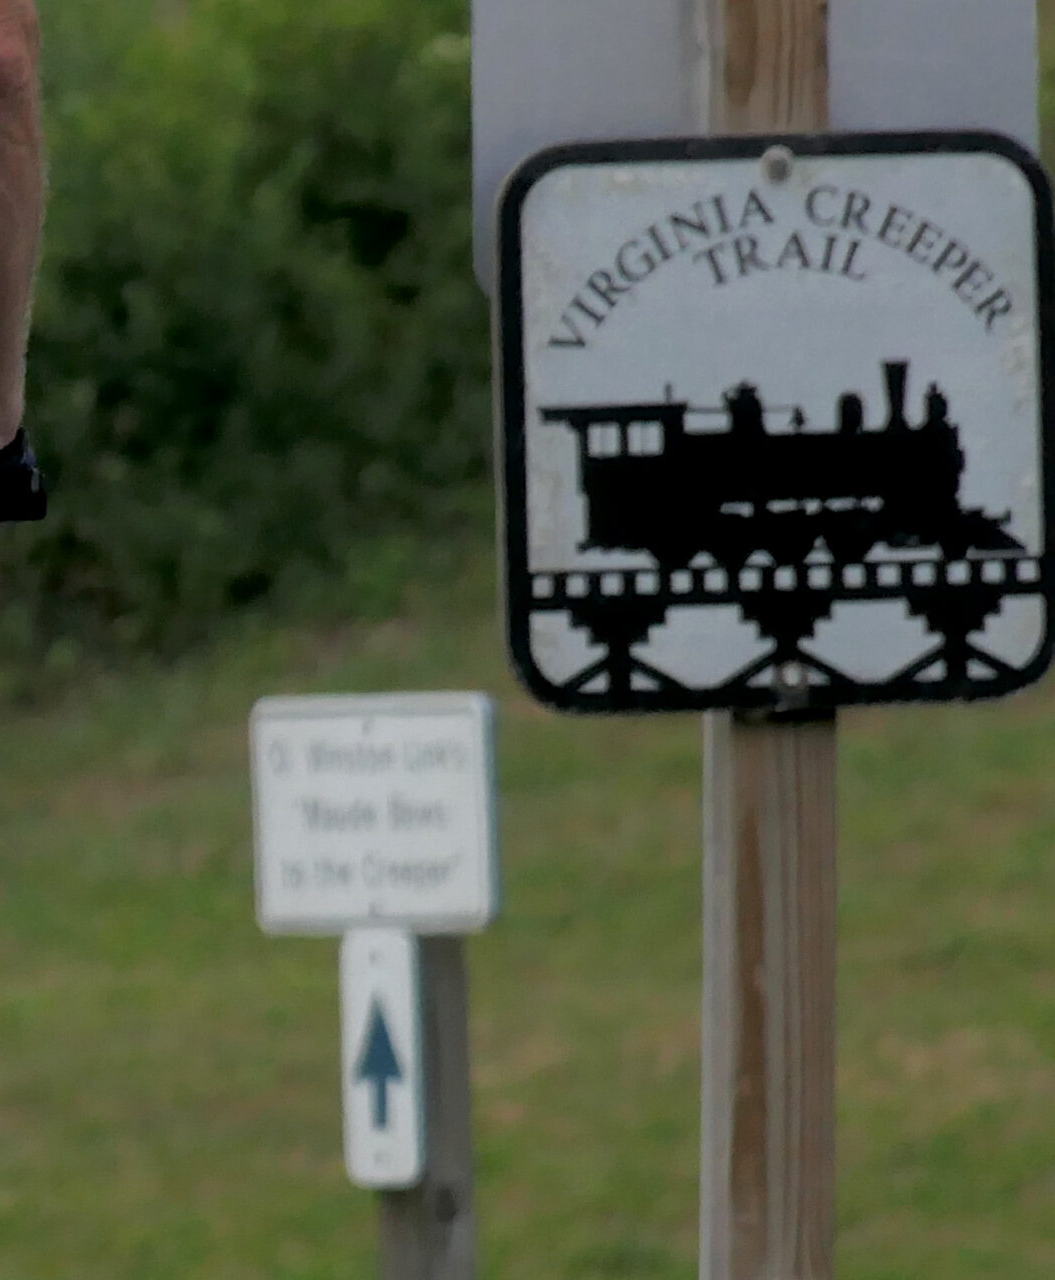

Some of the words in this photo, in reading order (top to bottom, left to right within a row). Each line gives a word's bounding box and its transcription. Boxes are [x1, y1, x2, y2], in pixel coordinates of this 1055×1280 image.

[547, 188, 775, 354] VIRGINIA
[803, 183, 1015, 332] CREEPER
[692, 229, 867, 287] TRAIL
